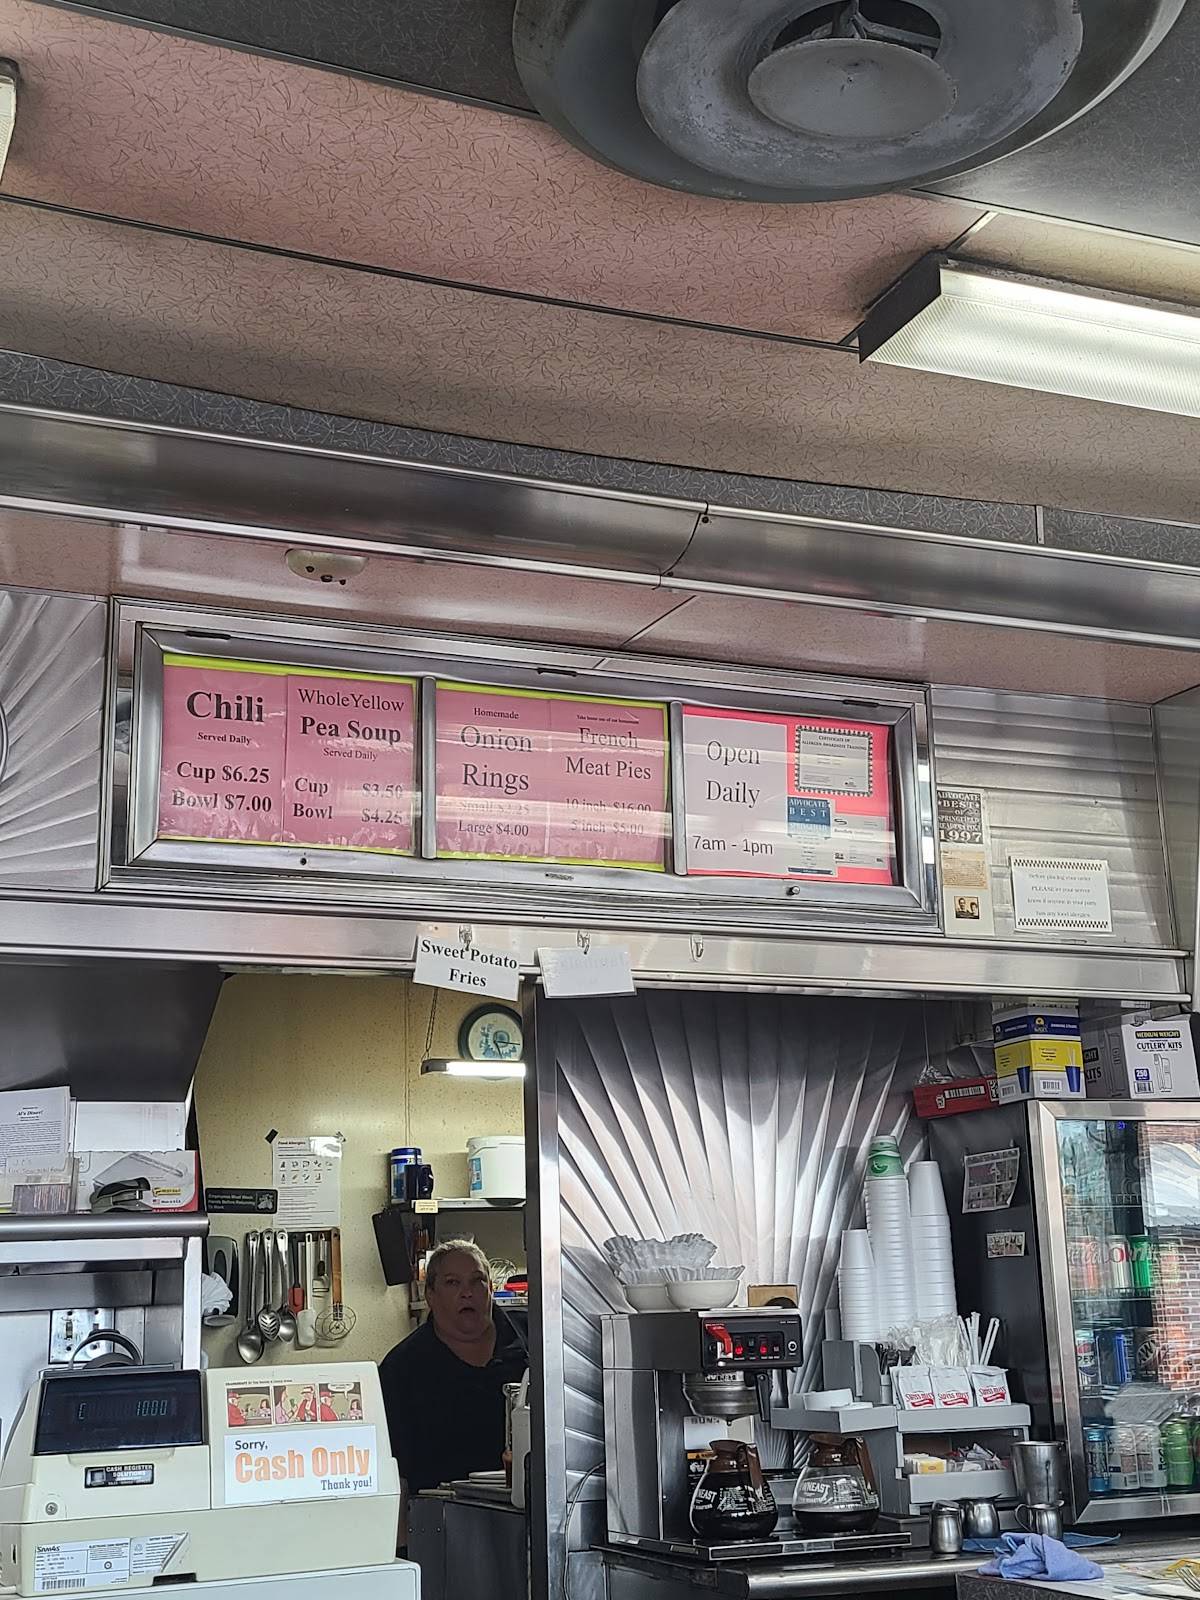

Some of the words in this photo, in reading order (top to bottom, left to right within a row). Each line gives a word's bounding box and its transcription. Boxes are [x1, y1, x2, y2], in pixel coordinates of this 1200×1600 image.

[186, 691, 265, 724] Chili
[473, 707, 520, 720] Homemade
[197, 732, 228, 744] Served
[228, 733, 252, 746] Daily
[300, 716, 340, 738] Pea
[347, 720, 401, 744] Soup
[460, 725, 533, 753] Onion
[578, 727, 639, 749] French
[323, 747, 353, 759] Served
[353, 749, 378, 762] Daily
[706, 740, 761, 766] Open
[176, 761, 216, 784] Cup
[222, 764, 270, 784] $6.25
[566, 756, 611, 777] Meat
[616, 760, 652, 780] Pies
[294, 777, 329, 798] Cup
[362, 782, 403, 800] $3.50
[462, 763, 530, 795] Rings
[171, 789, 219, 810] Bowl
[224, 793, 272, 813] $7.00
[706, 780, 761, 809] Daily
[788, 798, 828, 808] ADVOCATE
[937, 791, 980, 801] ADVOCATE
[943, 800, 974, 808] BEST
[292, 802, 333, 820] Bowl
[361, 808, 403, 825] $4.25
[565, 798, 579, 810] 10
[582, 798, 607, 812] inch
[612, 801, 652, 816] $16.00
[788, 807, 827, 817] BEST
[457, 819, 493, 836] Large
[496, 822, 530, 837] $4.00
[570, 819, 578, 832] 5
[582, 819, 606, 833] inch
[612, 822, 645, 835] $5.00
[939, 829, 982, 843] 1997
[692, 835, 726, 851] 7am
[742, 838, 774, 857] 1pm
[420, 939, 466, 960] Sweet
[469, 948, 518, 970] Potato
[449, 967, 487, 987] Fries
[1136, 1031, 1159, 1039] MEDIUM
[1158, 1030, 1180, 1038] WEIGHT
[1136, 1041, 1166, 1050] CUTLERY
[1167, 1041, 1183, 1049] KITS
[1135, 1069, 1148, 1077] 250
[234, 1439, 269, 1451] Sorry,
[234, 1449, 305, 1483] Cash
[310, 1445, 370, 1477] Only
[320, 1478, 351, 1491] Thank
[352, 1475, 373, 1490] you!
